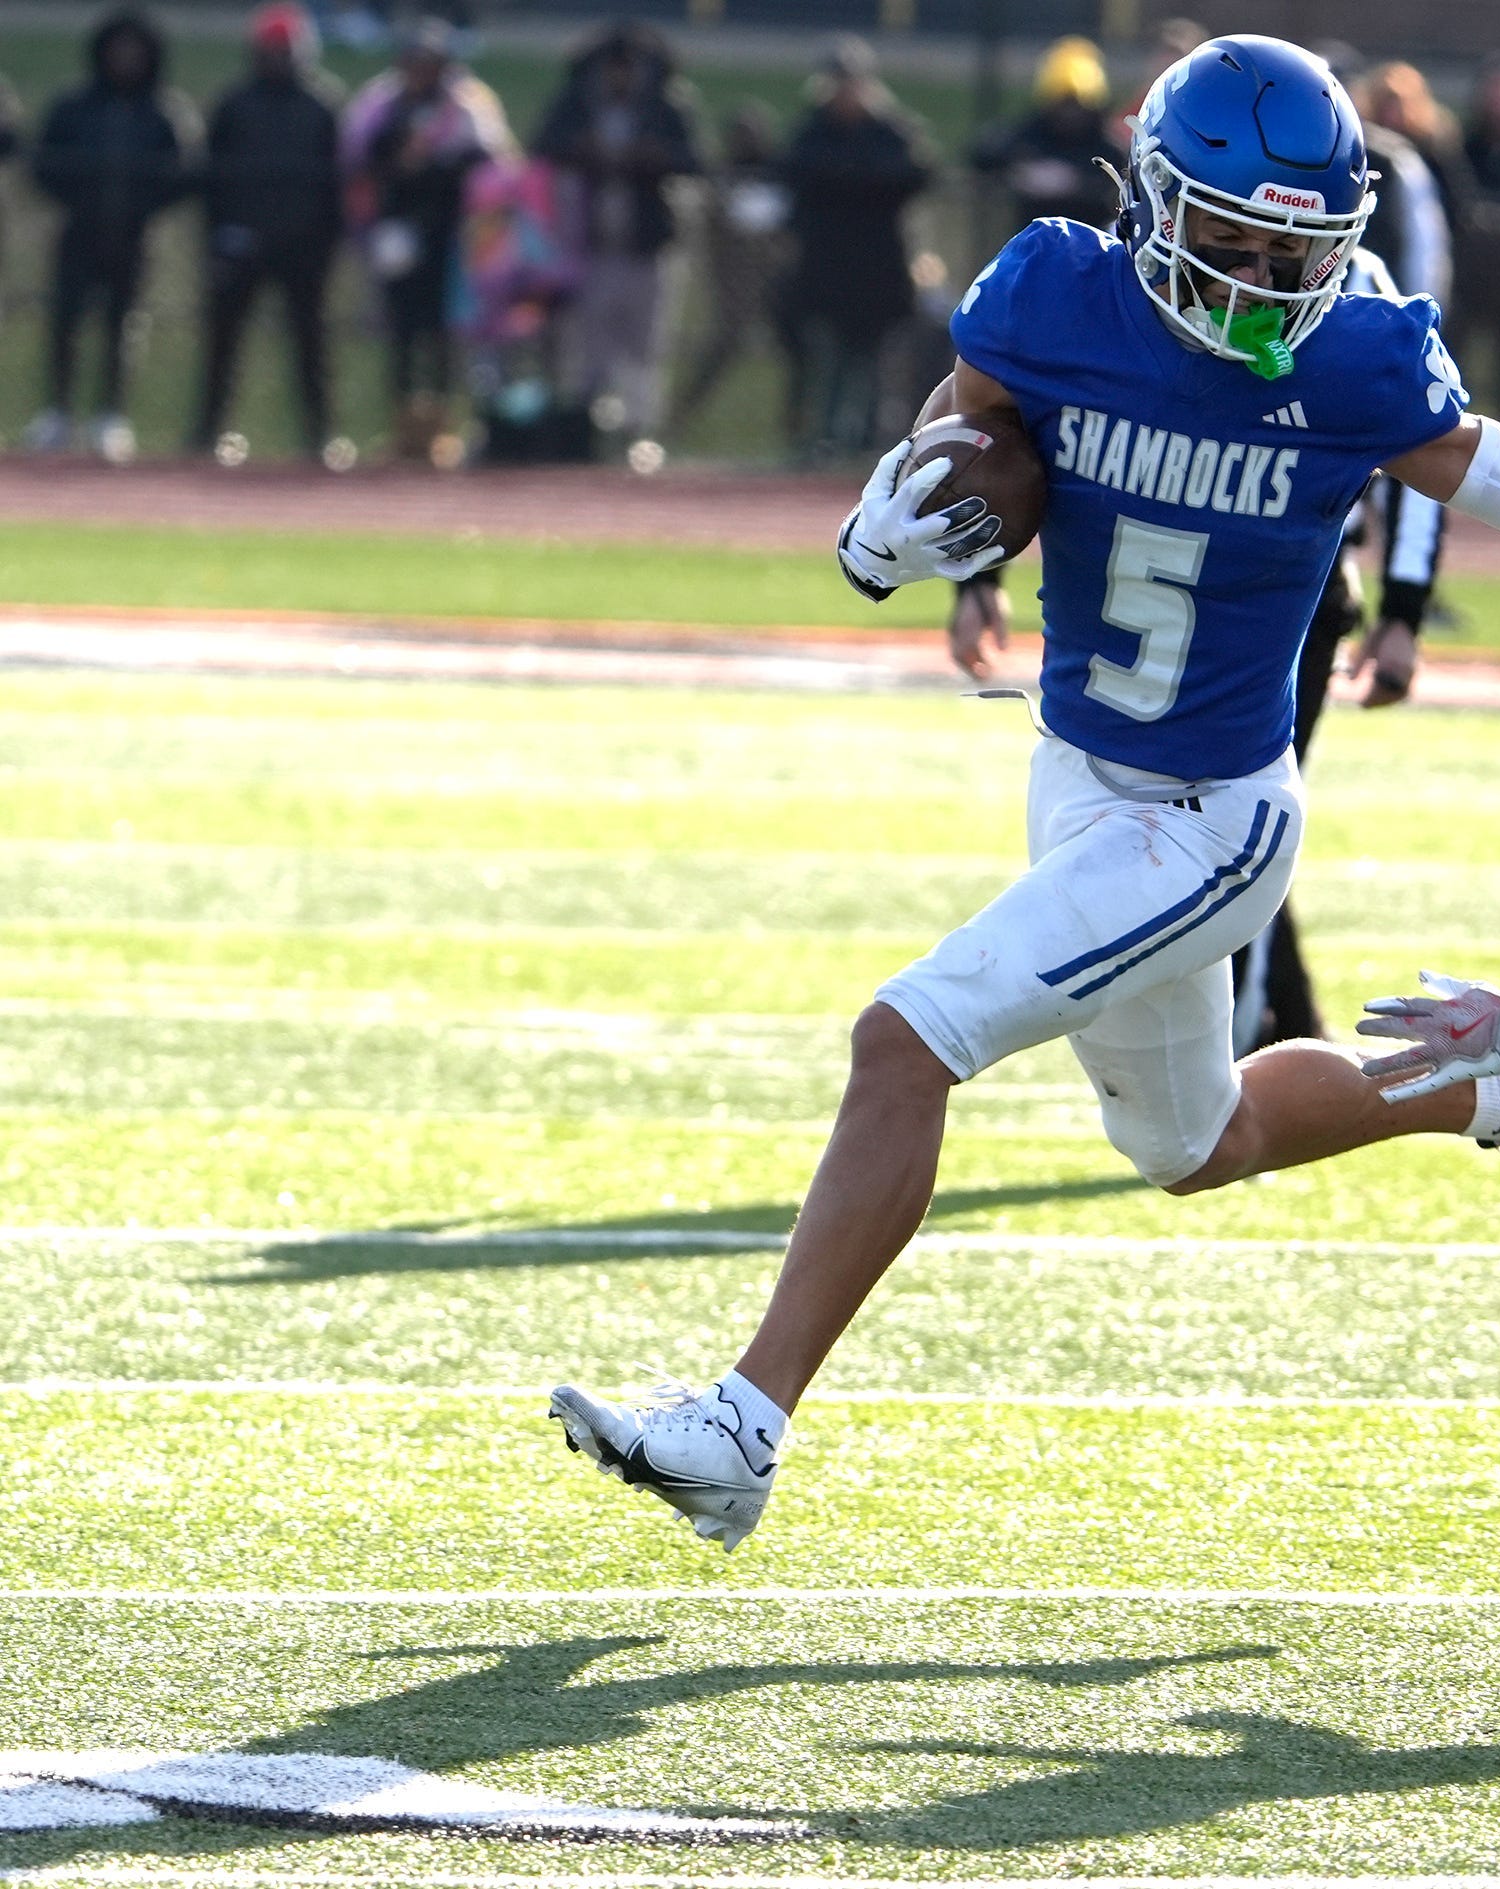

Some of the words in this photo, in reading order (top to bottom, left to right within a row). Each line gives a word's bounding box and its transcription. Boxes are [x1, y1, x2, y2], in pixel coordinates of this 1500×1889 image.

[1263, 188, 1319, 210] Riddell
[1302, 251, 1340, 291] Riddell
[1055, 405, 1299, 518] SHAMROCKS
[1083, 513, 1210, 722] 5
